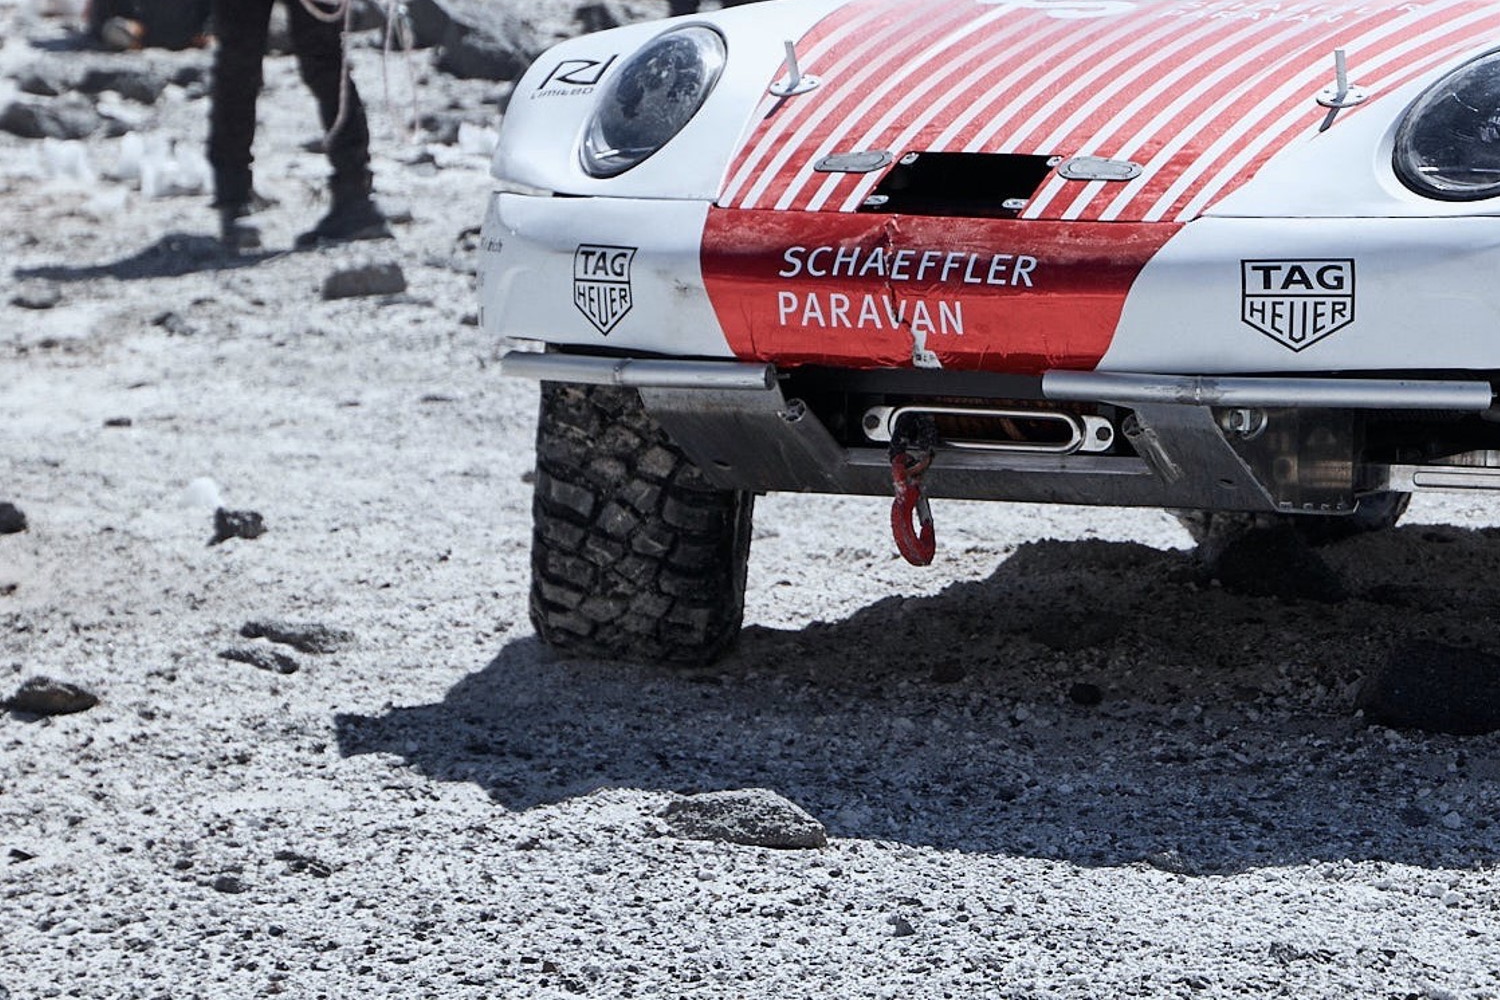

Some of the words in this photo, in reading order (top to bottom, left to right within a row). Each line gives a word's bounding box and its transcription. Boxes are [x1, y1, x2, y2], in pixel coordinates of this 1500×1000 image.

[579, 250, 628, 277] TAG
[779, 246, 1038, 287] SCHAEFFLER
[1252, 265, 1345, 290] TAG
[577, 285, 628, 327] HEUER
[778, 292, 964, 335] PARAVAN
[1250, 301, 1348, 343] HEUER
